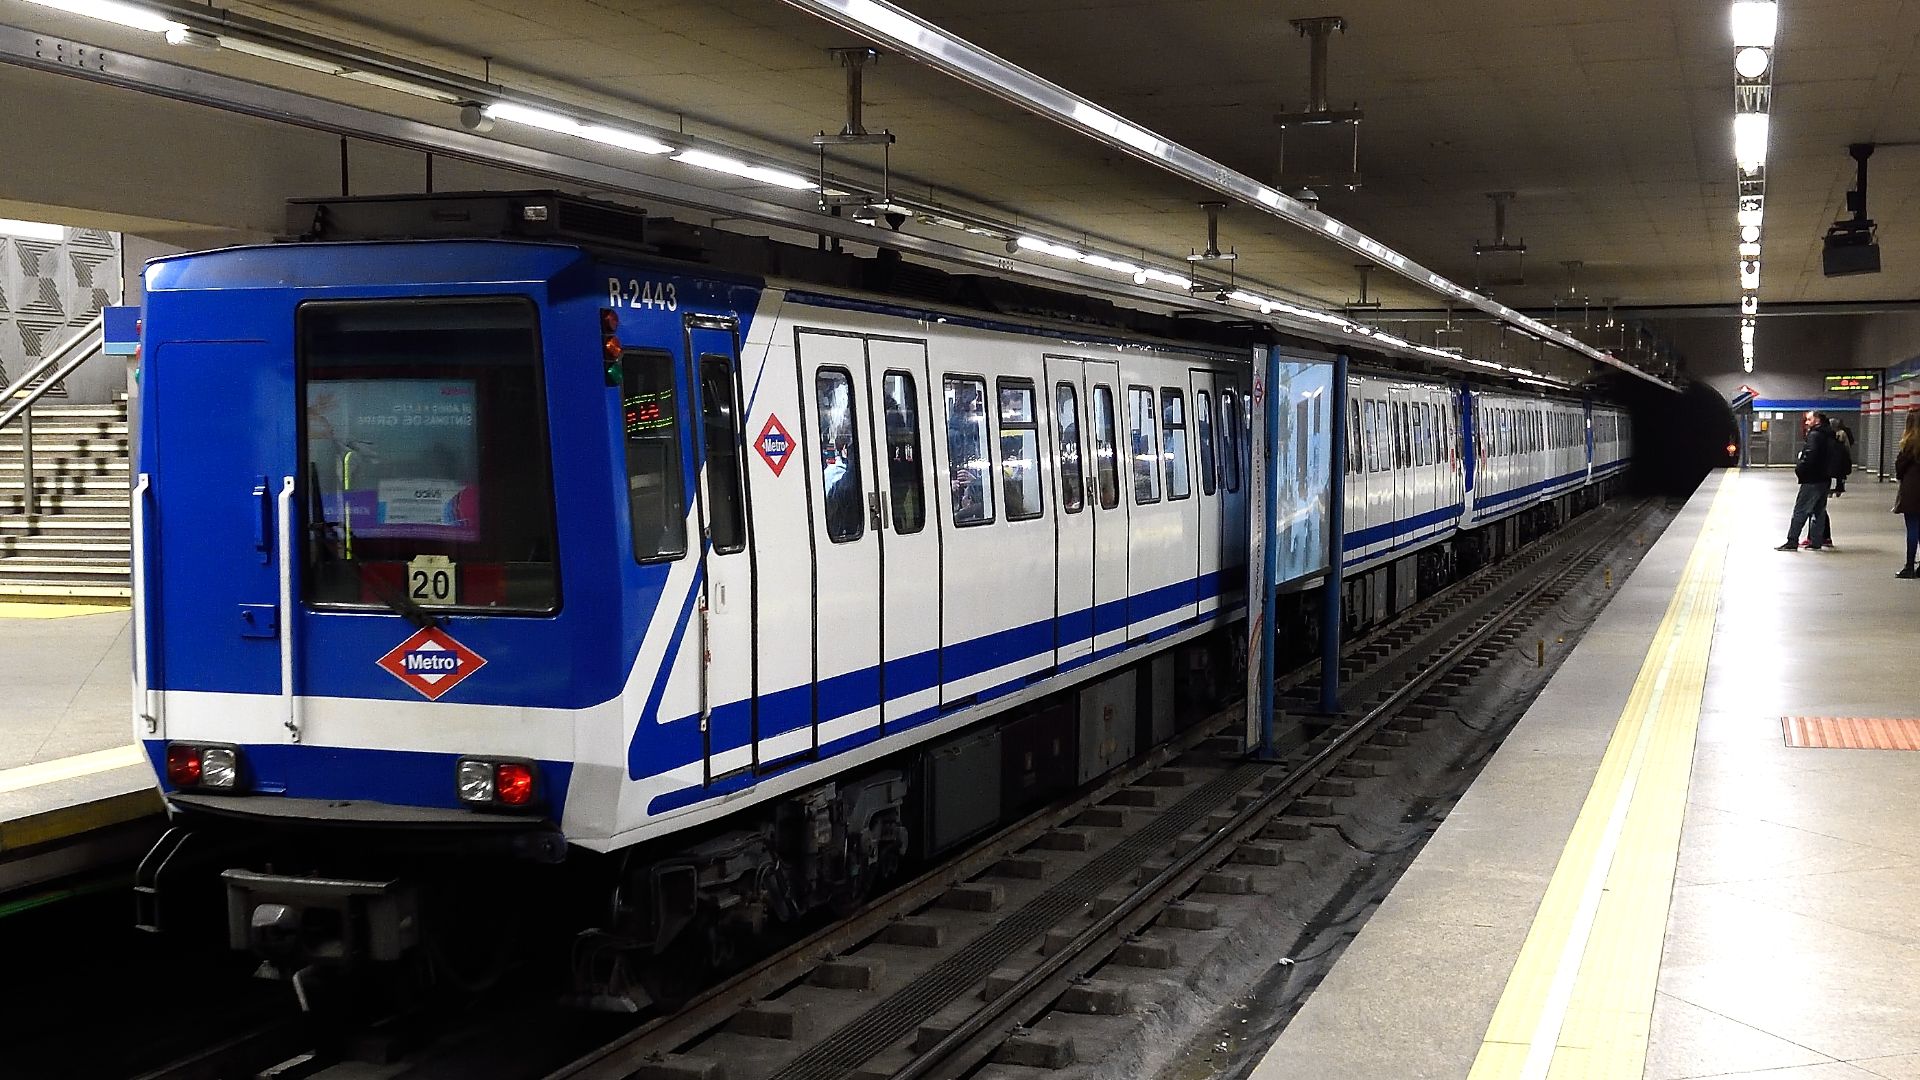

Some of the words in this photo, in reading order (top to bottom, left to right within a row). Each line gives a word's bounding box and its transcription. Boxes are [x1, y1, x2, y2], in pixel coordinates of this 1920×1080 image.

[609, 278, 677, 311] R-2443
[765, 438, 786, 452] Metro
[413, 571, 449, 599] 20
[408, 654, 454, 670] Metro
